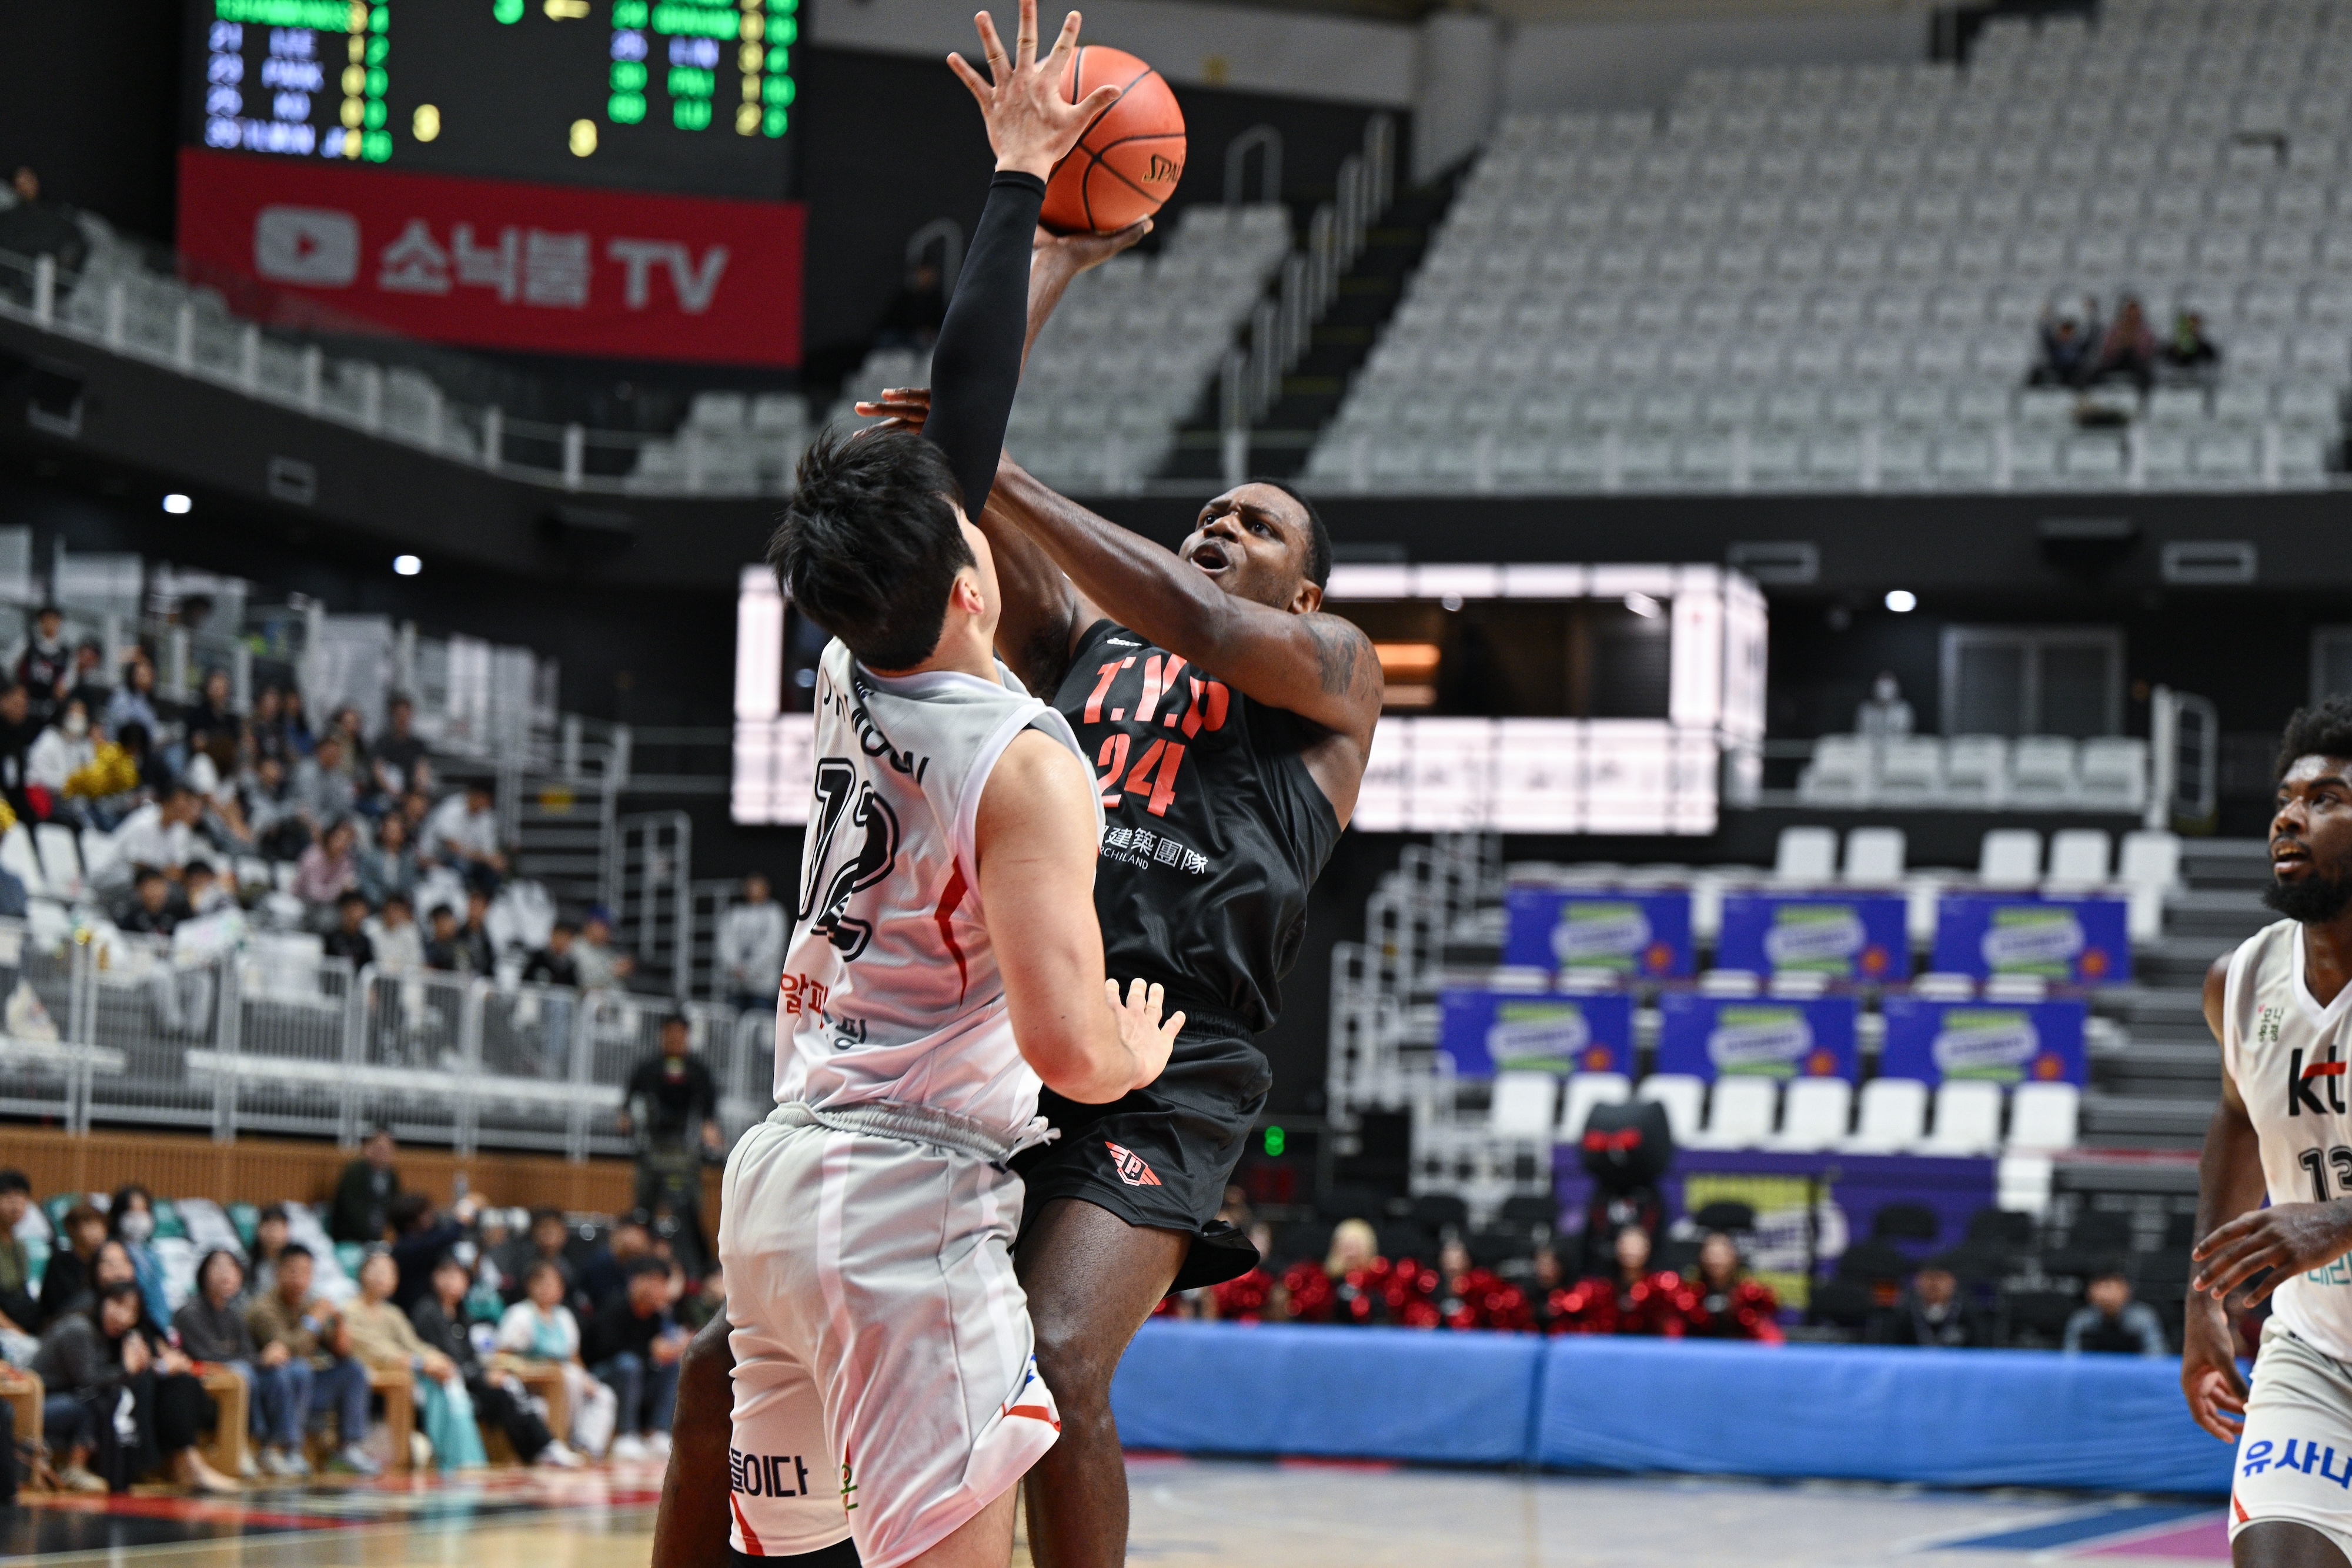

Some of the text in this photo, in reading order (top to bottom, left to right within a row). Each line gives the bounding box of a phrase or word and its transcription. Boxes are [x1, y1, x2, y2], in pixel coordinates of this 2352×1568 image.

[607, 240, 729, 314] TV
[1097, 733, 1186, 817] 24
[797, 757, 900, 962] 12
[1103, 825, 1208, 875] 建築團隊
[2288, 1045, 2347, 1116] kt
[2243, 1438, 2352, 1490] 유사나
